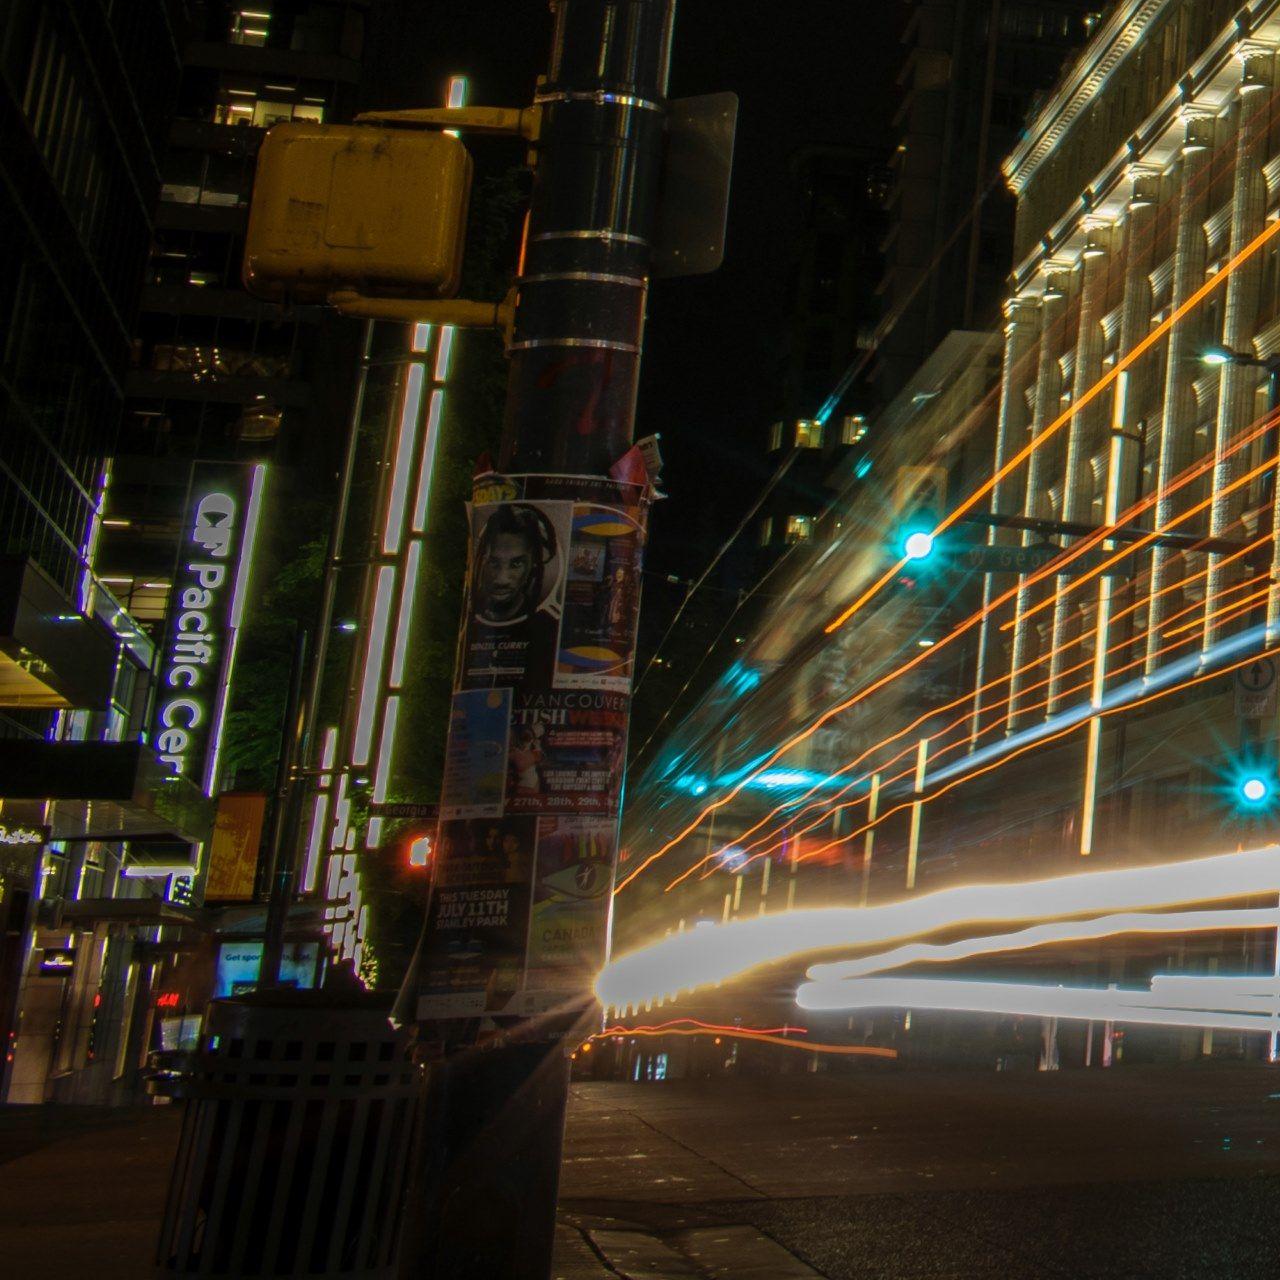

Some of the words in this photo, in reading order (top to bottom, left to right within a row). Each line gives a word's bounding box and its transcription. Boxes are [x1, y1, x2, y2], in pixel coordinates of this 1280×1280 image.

[167, 563, 226, 687] Pacific
[497, 641, 530, 650] CURRY
[459, 888, 511, 903] TUESDAY
[436, 902, 466, 920] JULY
[467, 899, 510, 918] 11TH
[476, 914, 509, 928] PARK
[225, 954, 240, 962] Get
